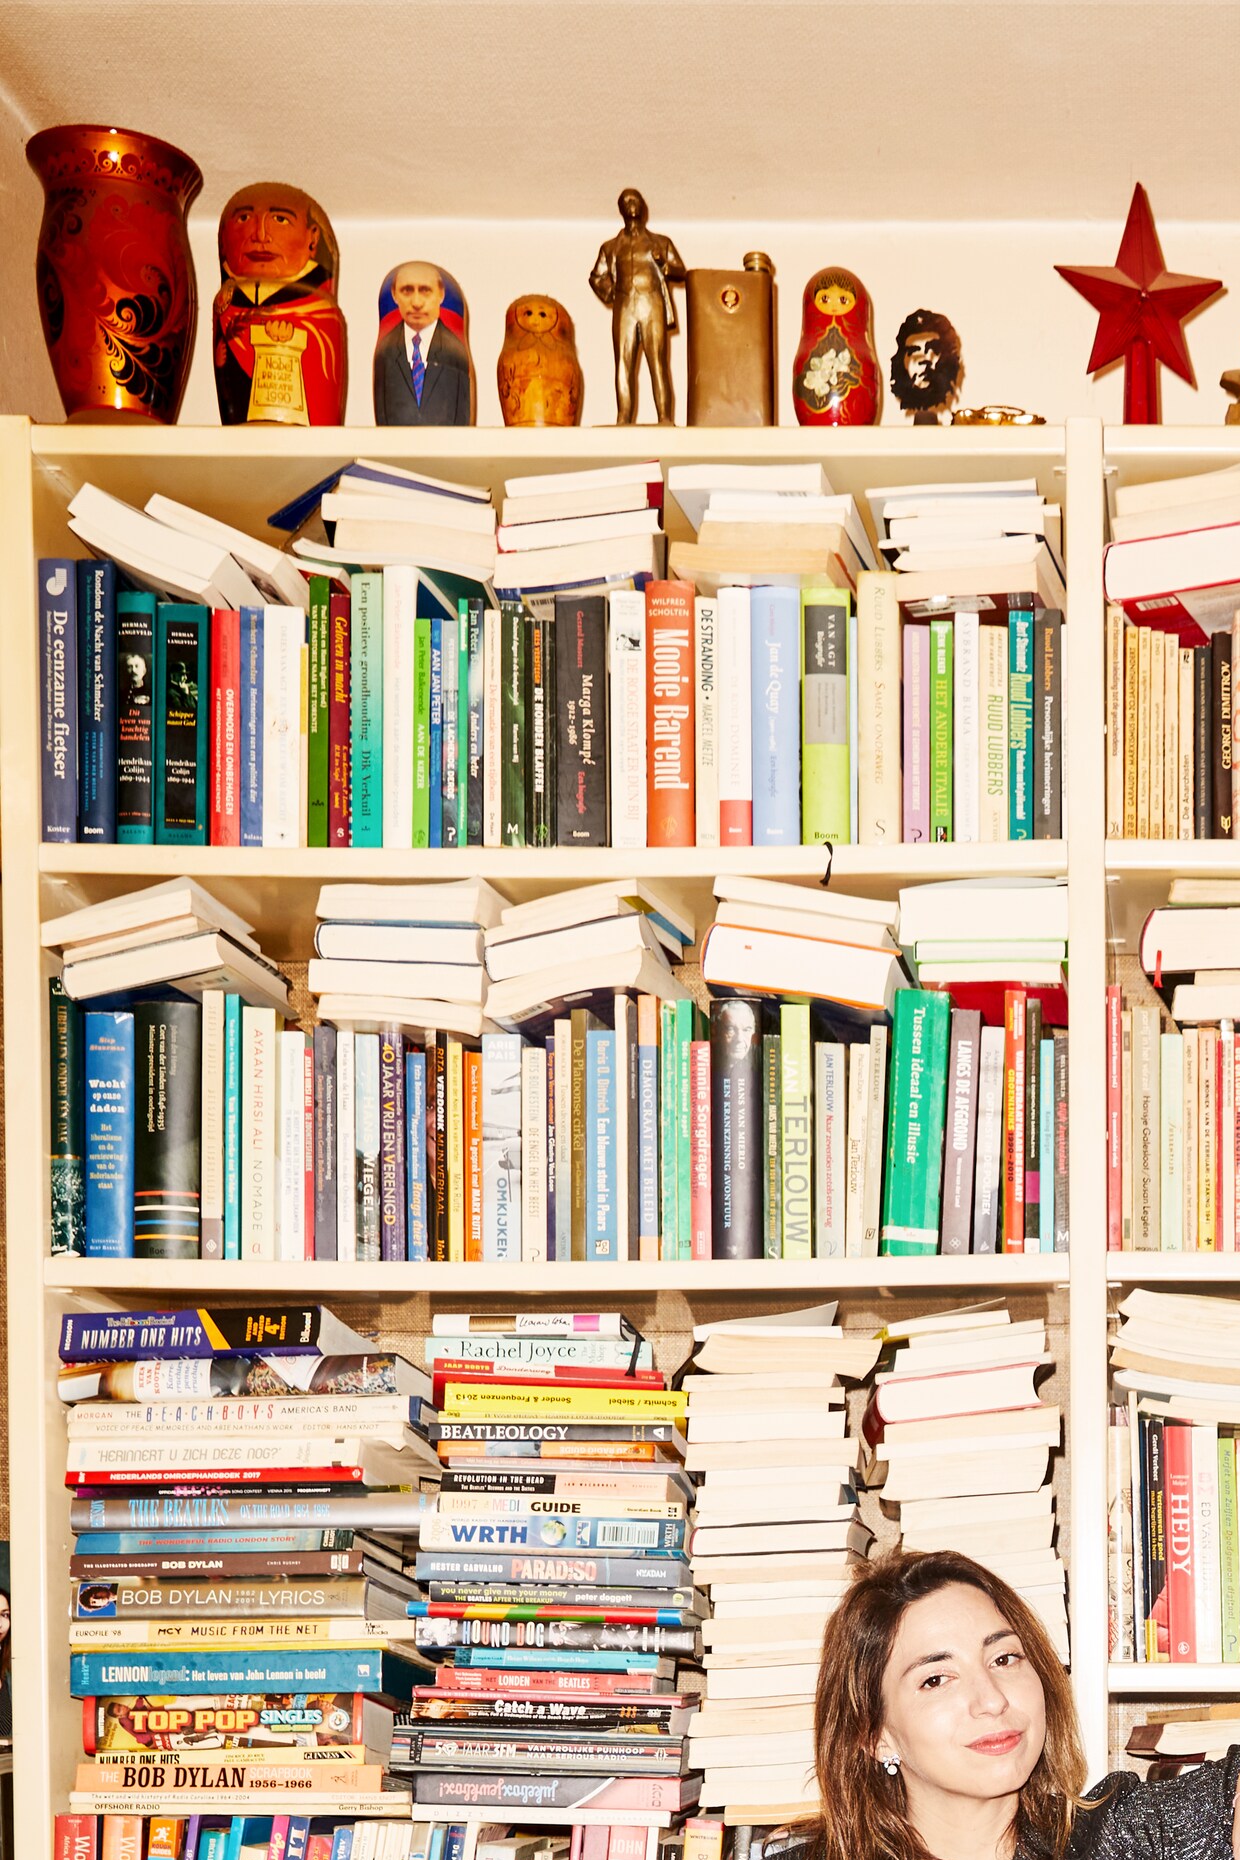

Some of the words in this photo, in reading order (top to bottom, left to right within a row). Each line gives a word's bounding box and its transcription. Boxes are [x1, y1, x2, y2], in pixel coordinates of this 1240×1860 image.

[265, 356, 293, 372] Nobel
[266, 391, 292, 404] 1990
[53, 611, 67, 633] De
[649, 609, 689, 617] SCHOLTEN
[653, 629, 689, 697] Mooie
[52, 638, 65, 719] eenzame
[1222, 661, 1232, 718] DIMITROV
[579, 674, 593, 715] Marga
[226, 689, 234, 740] OVERMOED
[53, 722, 70, 779] fietser
[226, 743, 234, 754] EN
[579, 719, 596, 765] Klompé
[653, 705, 689, 790] Barend
[1222, 724, 1232, 769] GEORGI
[166, 759, 196, 767] Hendrikus
[171, 767, 191, 775] Colijn
[226, 757, 234, 815] ONBEHAGEN
[47, 825, 70, 833] Koster
[955, 1040, 972, 1075] LANGS
[89, 1080, 126, 1089] Wacht
[697, 1048, 710, 1100] Winnie
[92, 1092, 104, 1100] op
[106, 1092, 122, 1100] onze
[737, 1078, 745, 1106] HANS
[955, 1079, 970, 1094] DE
[90, 1103, 125, 1113] daden
[737, 1109, 745, 1129] VAN
[952, 1096, 970, 1151] AFGROND
[695, 1105, 710, 1188] Sorgdrager
[737, 1132, 745, 1170] MIERLO
[784, 1096, 809, 1244] TERLOUW
[81, 1330, 135, 1350] NUMBER
[140, 1328, 165, 1348] ONE
[170, 1327, 203, 1346] HITS
[460, 1340, 522, 1358] Rachel
[528, 1341, 577, 1362] Joyce
[440, 1424, 569, 1440] BEATLEOLOGY
[453, 1474, 497, 1483] REVOLUTION
[500, 1475, 505, 1484] IN
[508, 1475, 523, 1484] THE
[526, 1475, 545, 1484] HEAD
[129, 1499, 160, 1528] THE
[164, 1499, 230, 1527] BEATLES
[530, 1501, 582, 1514] GUIDE
[451, 1524, 529, 1544] WRTH
[1170, 1492, 1193, 1577] HEDY
[162, 1561, 186, 1569] BOB
[188, 1561, 223, 1569] DYLAN
[430, 1562, 461, 1572] HESTER
[464, 1562, 503, 1573] CARVALHO
[511, 1558, 598, 1582] PARADISO
[121, 1590, 163, 1605] BOB
[169, 1590, 232, 1604] DYLAN
[259, 1590, 325, 1606] LYRICS
[128, 1709, 192, 1734] TOP
[194, 1709, 261, 1734] POP
[260, 1709, 324, 1724] SINGLES
[122, 1766, 166, 1788] BOB
[174, 1767, 247, 1789] DYLAN
[612, 1838, 643, 1855] JOHN
